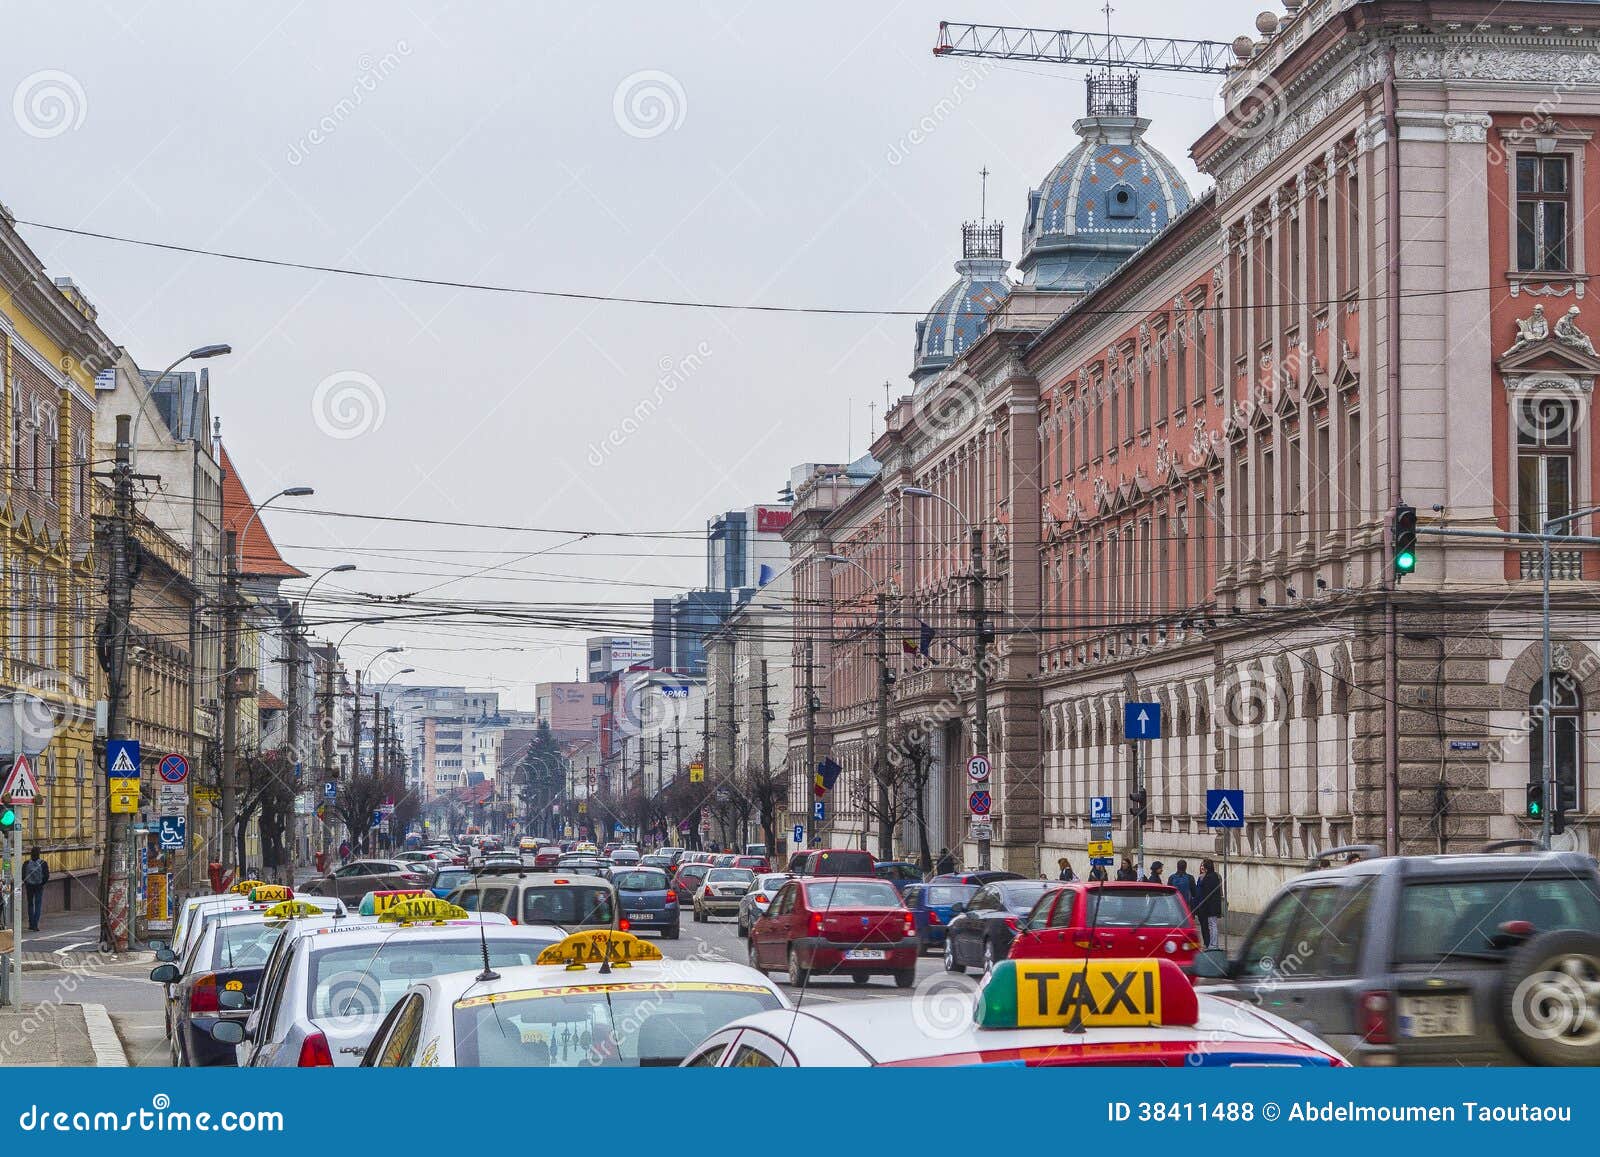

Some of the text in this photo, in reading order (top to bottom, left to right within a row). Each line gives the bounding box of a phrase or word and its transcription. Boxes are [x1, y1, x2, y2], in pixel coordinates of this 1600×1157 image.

[662, 690, 688, 698] KPMG
[972, 761, 986, 775] 50
[1091, 798, 1104, 818] P
[178, 816, 185, 828] P
[257, 887, 286, 900] TAXI
[406, 900, 437, 916] TAXI
[572, 940, 632, 961] TAXI
[542, 982, 667, 997] NAPOCA
[1025, 971, 1154, 1017] TAXI
